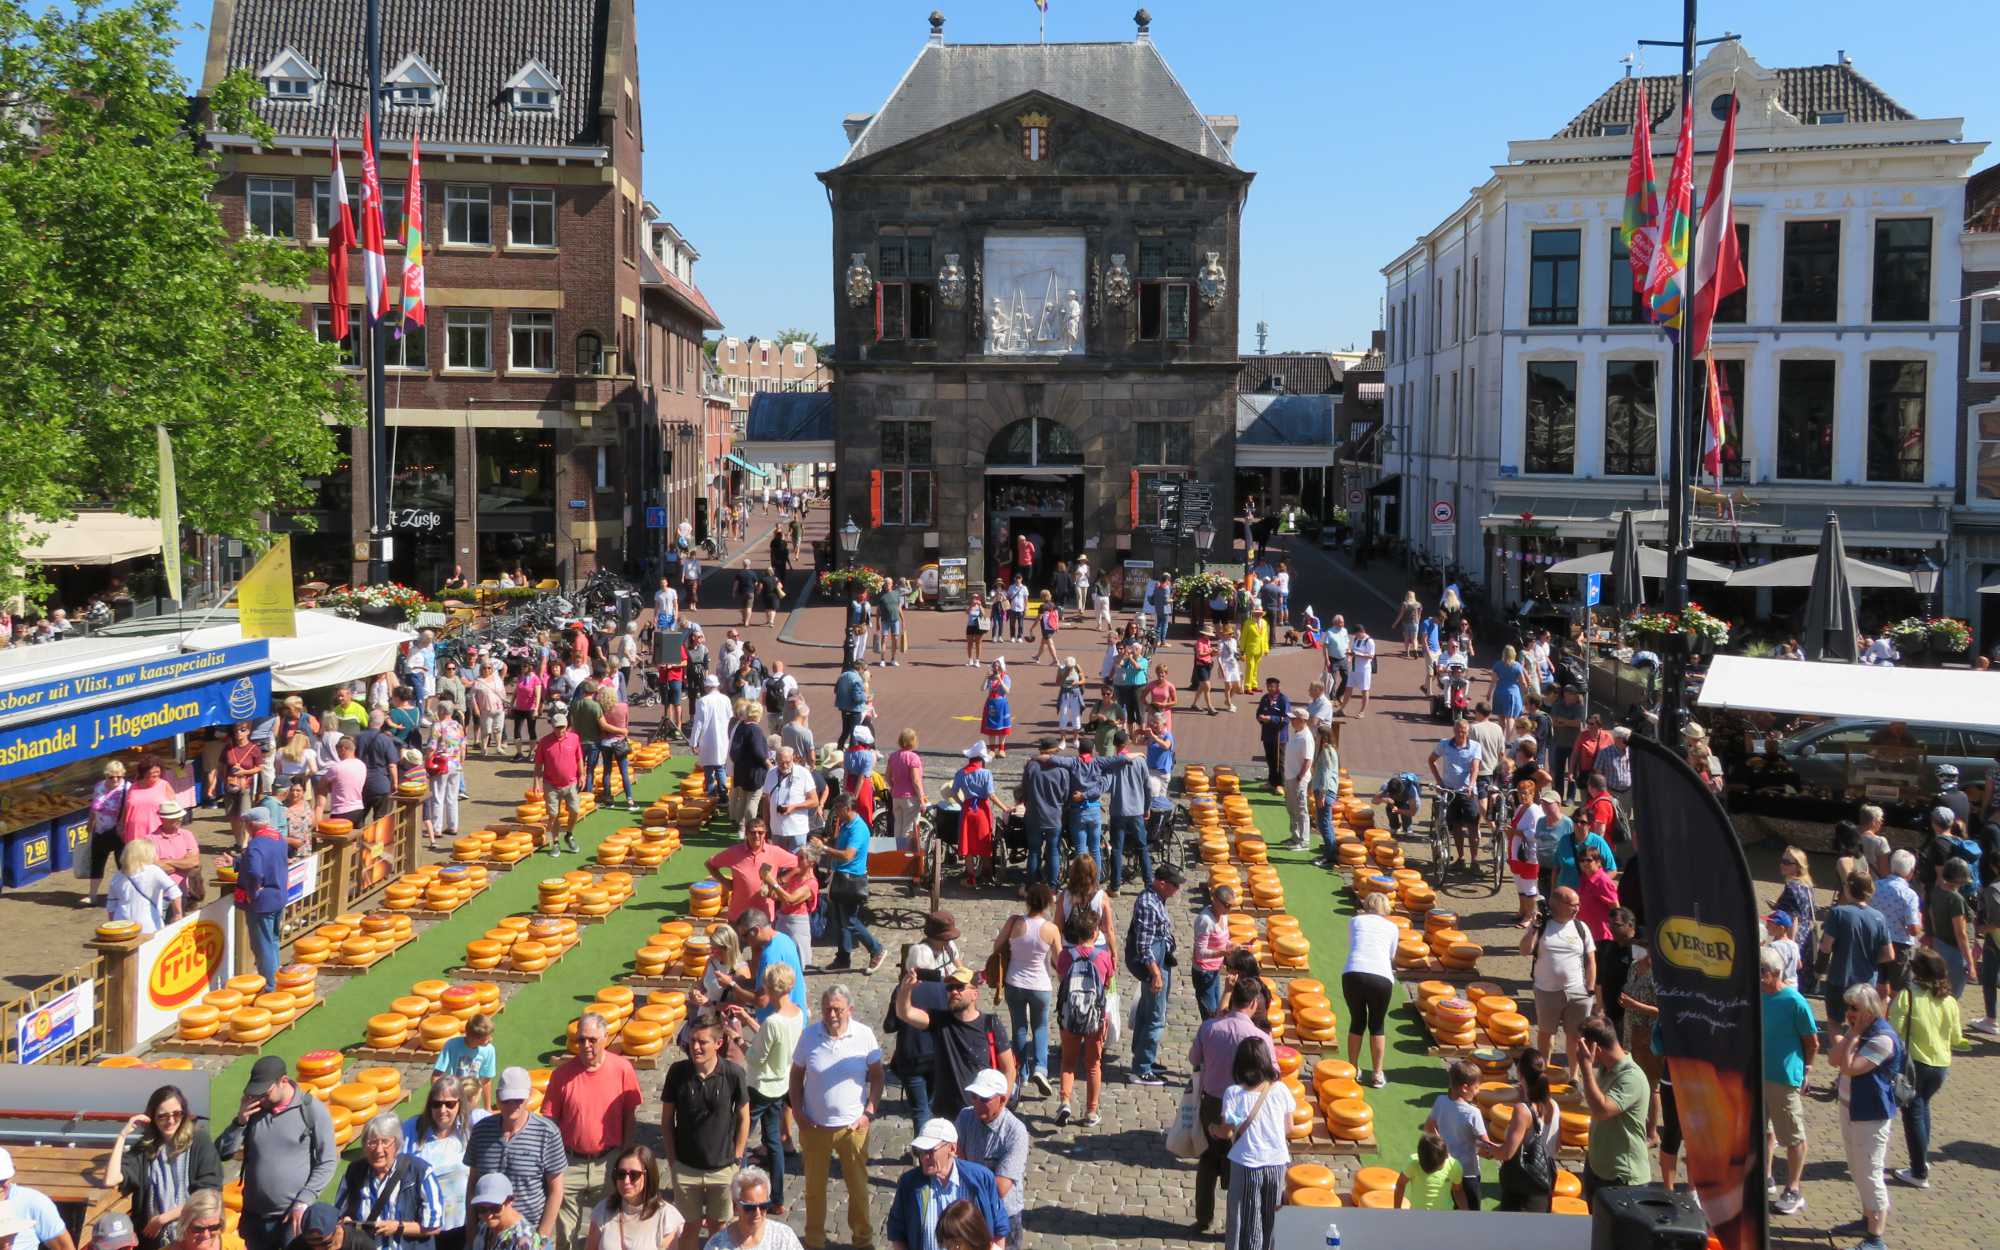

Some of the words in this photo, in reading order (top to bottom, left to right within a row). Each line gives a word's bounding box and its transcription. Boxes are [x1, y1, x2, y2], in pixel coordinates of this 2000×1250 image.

[400, 508, 441, 531] Zusje
[48, 683, 71, 700] uit
[74, 677, 113, 695] Vlist,
[117, 671, 136, 686] uw
[140, 652, 225, 681] kaasspecialist
[90, 719, 105, 749] J.
[108, 701, 200, 738] Hogendoorn
